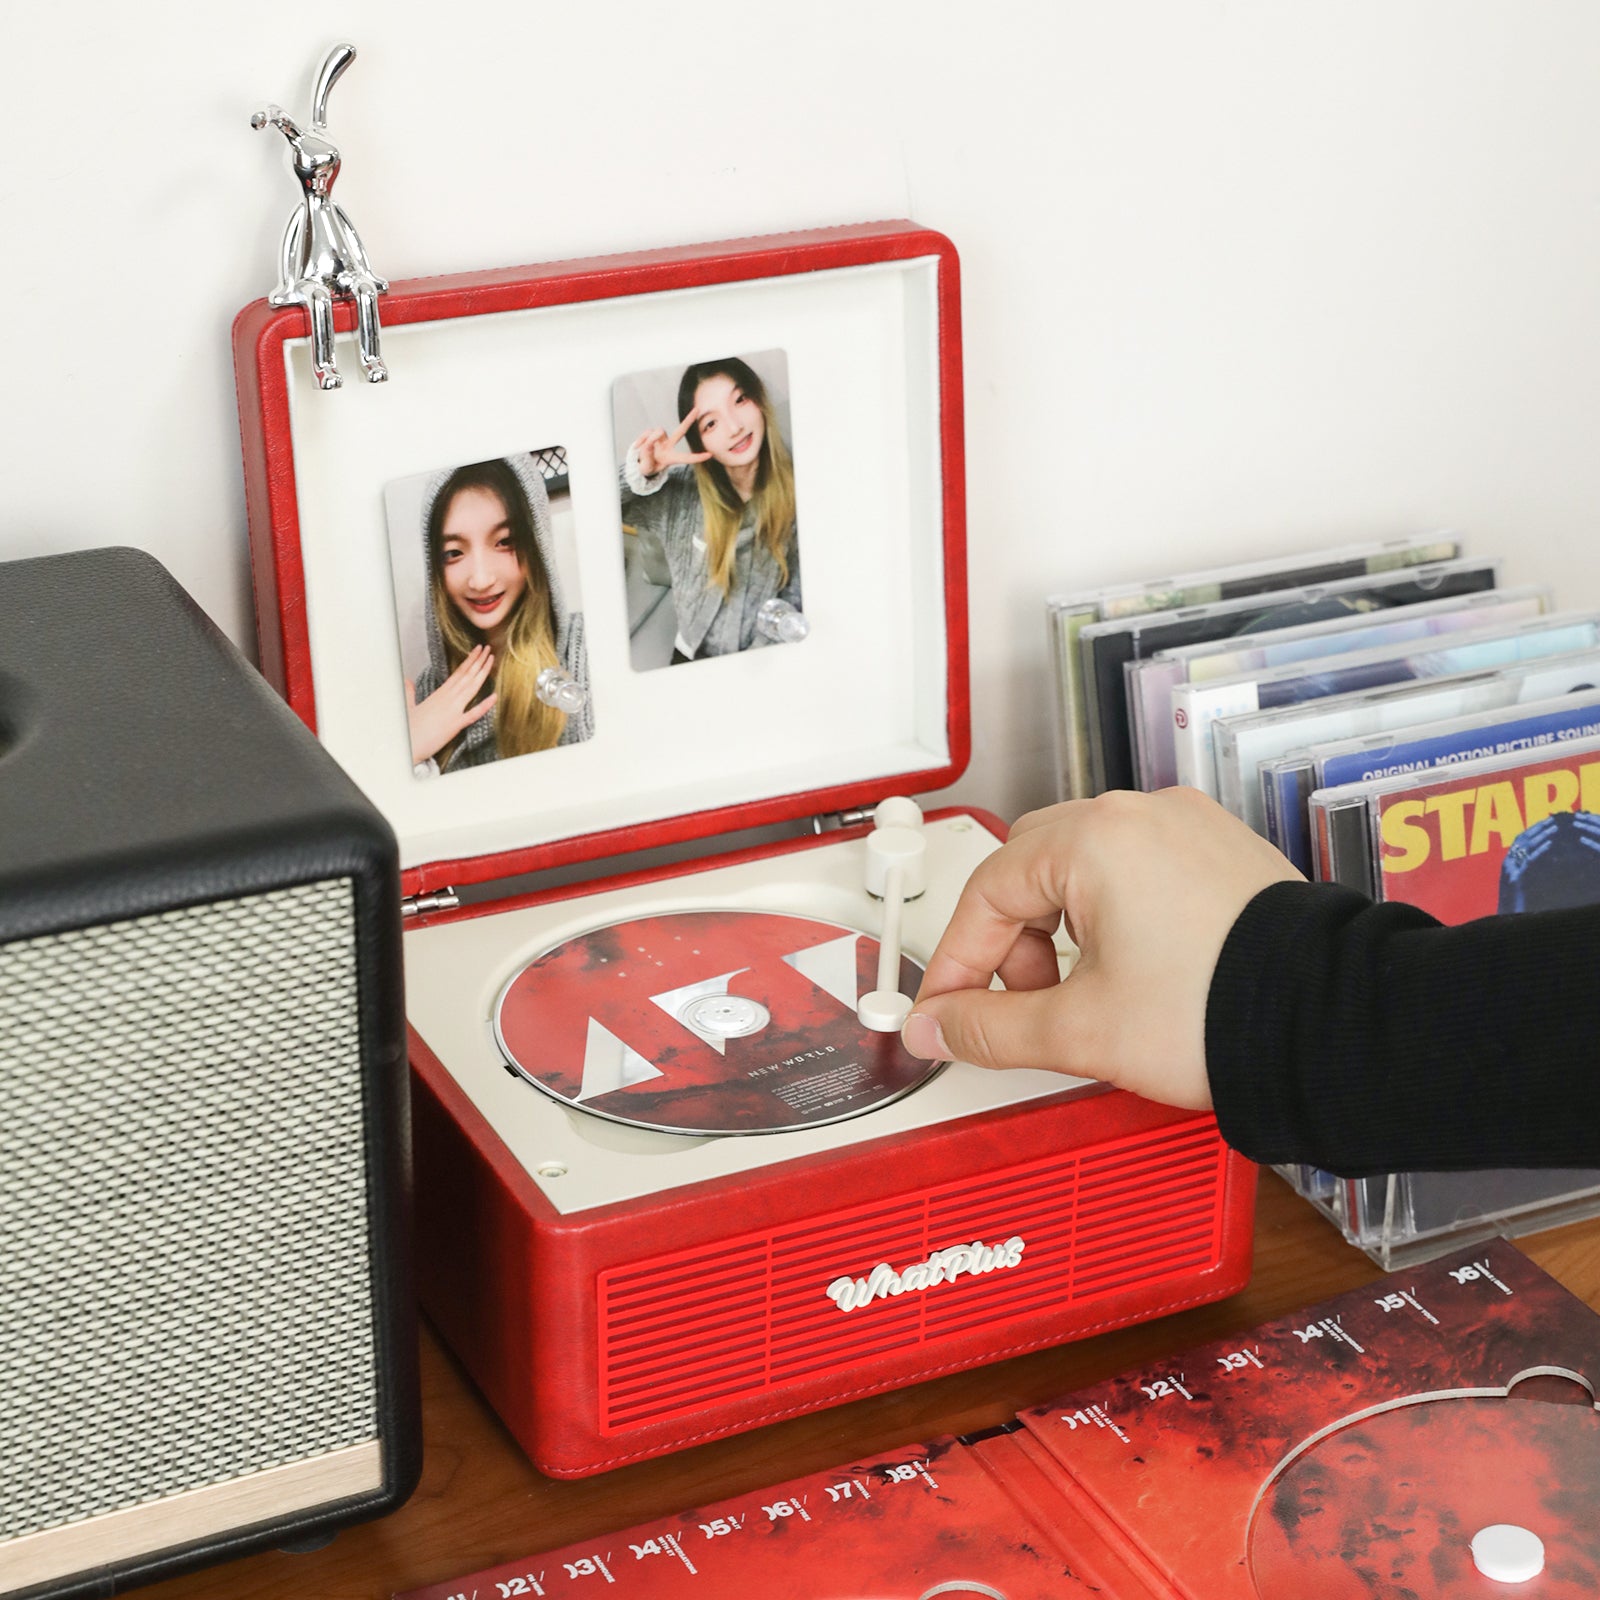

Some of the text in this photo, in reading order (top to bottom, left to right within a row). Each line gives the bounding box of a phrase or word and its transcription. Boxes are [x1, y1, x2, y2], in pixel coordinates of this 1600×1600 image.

[1362, 722, 1600, 780] ORIGINAL MOTION PICTURE SOUN
[748, 1045, 836, 1079] NEW WORLD
[826, 1236, 1026, 1312] WhatPlus
[1421, 1309, 1440, 1325] YOUTH
[1327, 1330, 1344, 1342] FIFTY
[1331, 1323, 1344, 1334] TWO
[1341, 1332, 1365, 1353] HUNDRED
[1085, 1408, 1106, 1428] YOU CAN
[1092, 1405, 1131, 1444] WALK AS LONG AS
[912, 1461, 939, 1489] NEW WORLD
[852, 1480, 871, 1500] ARRIVAL
[790, 1498, 812, 1521] GOD TREE
[727, 1516, 742, 1530] SPLIT
[657, 1536, 676, 1557] WITH ET
[665, 1534, 698, 1575] CONVERSATIONS
